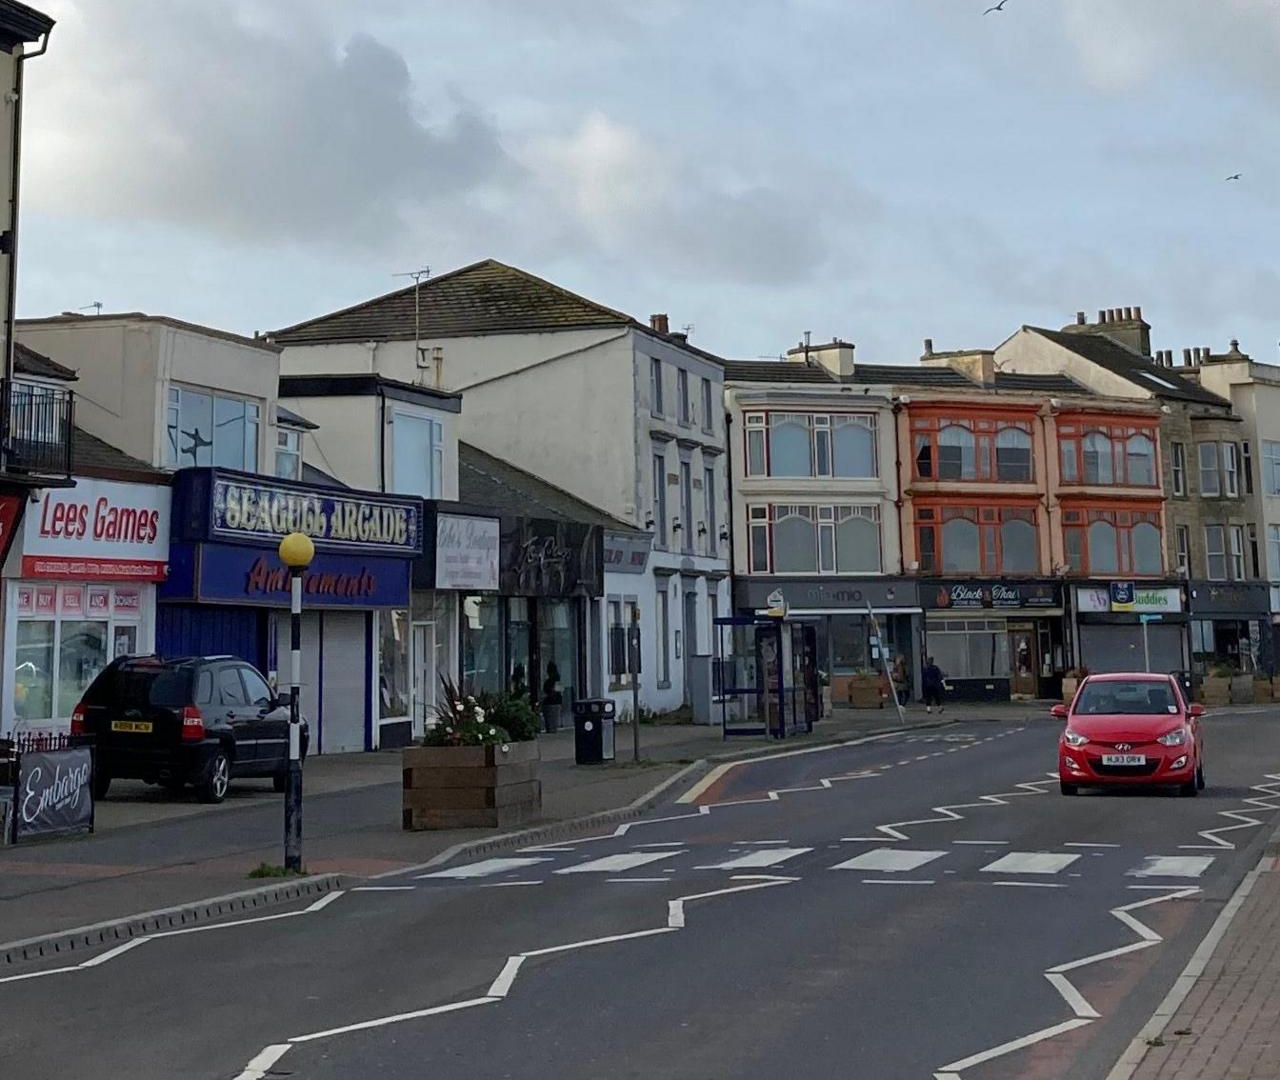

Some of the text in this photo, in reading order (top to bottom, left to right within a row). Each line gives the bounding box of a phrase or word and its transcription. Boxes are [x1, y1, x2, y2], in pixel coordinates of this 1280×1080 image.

[39, 492, 159, 545] Lees Games
[225, 485, 327, 537] SEAGULL
[330, 500, 408, 545] ARCADE
[38, 594, 51, 606] BUY
[65, 595, 79, 606] SELL
[90, 595, 105, 608] AND
[951, 584, 1020, 601] Black Thai
